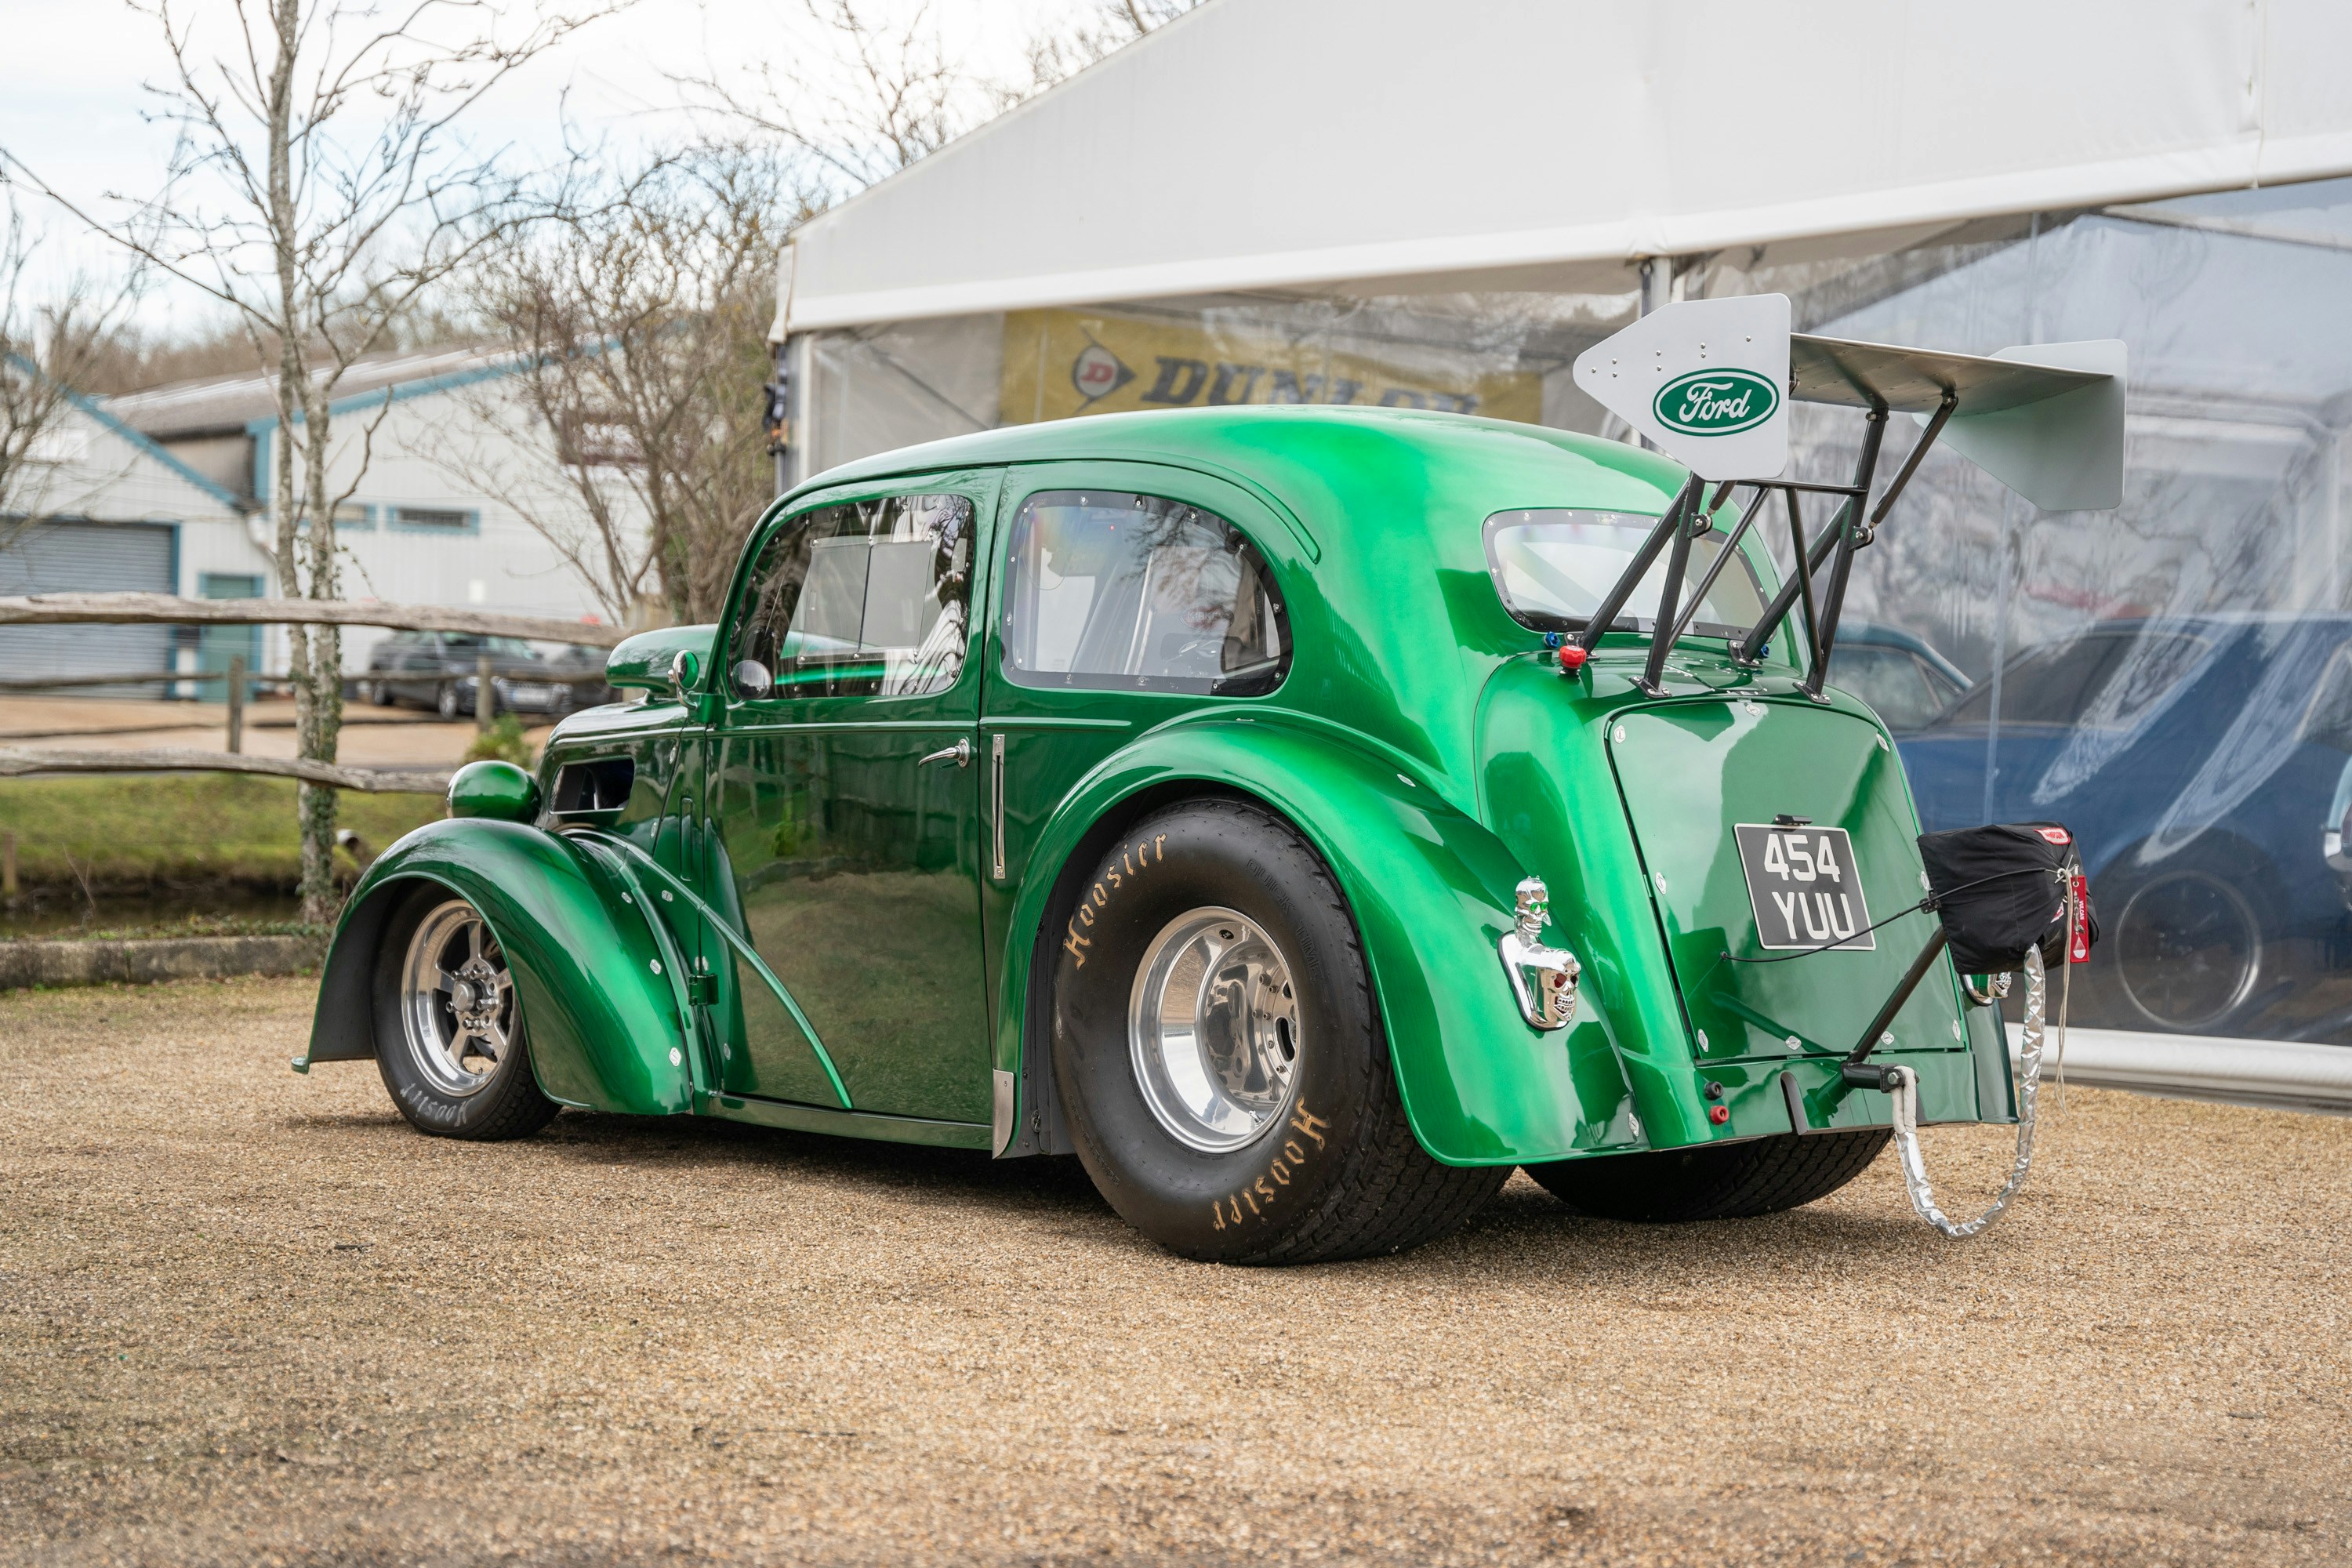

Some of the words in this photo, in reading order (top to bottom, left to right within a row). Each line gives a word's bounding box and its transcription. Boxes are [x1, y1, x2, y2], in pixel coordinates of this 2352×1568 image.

[1080, 361, 1114, 383] D
[1679, 382, 1752, 423] Ford
[1764, 833, 1841, 883] 454
[1063, 833, 1167, 971] Hoosier
[1247, 859, 1295, 914] QUICK
[1772, 891, 1856, 940] YUU
[1213, 1094, 1331, 1231] Hoosier
